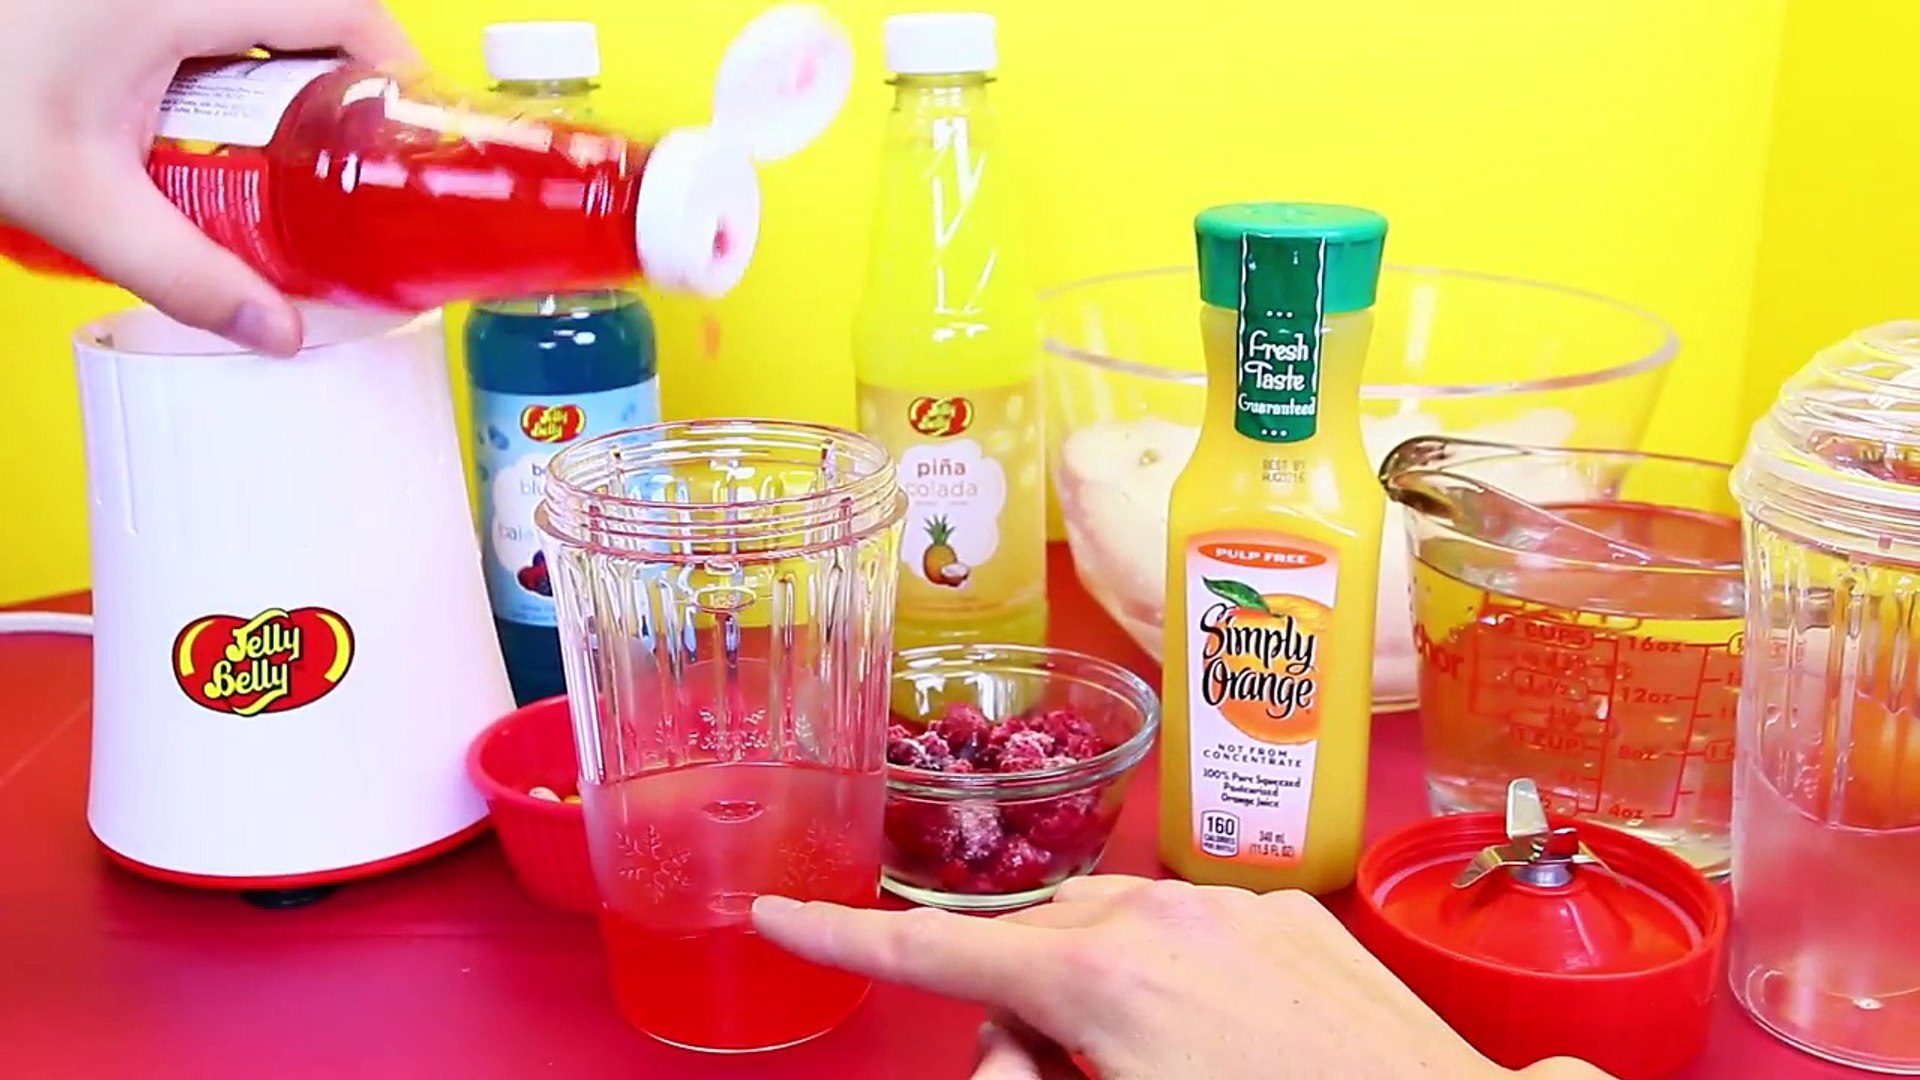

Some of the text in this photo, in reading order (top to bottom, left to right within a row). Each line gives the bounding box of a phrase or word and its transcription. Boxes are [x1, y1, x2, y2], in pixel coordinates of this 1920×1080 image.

[1249, 329, 1309, 361] Fresh
[1243, 360, 1306, 391] Taste
[1238, 393, 1316, 416] Guaranteed
[917, 457, 966, 478] piña
[905, 480, 978, 498] colada
[1215, 548, 1309, 564] PULP FREE
[225, 608, 300, 662] Jelly
[1199, 603, 1315, 675] Simply
[1525, 622, 1586, 646] CUPS
[1628, 636, 1682, 653] 16oz
[204, 659, 289, 716] Belly
[1202, 657, 1313, 719] Orange
[1622, 686, 1675, 704] 12oz
[1203, 749, 1301, 768] CONCENTRATE
[1218, 743, 1287, 757] NOT FROM
[1203, 768, 1301, 788] 100% Pure Squeezed
[1221, 792, 1279, 808] Orange Juice
[1608, 804, 1643, 819] 4oz
[1207, 816, 1235, 835] 160
